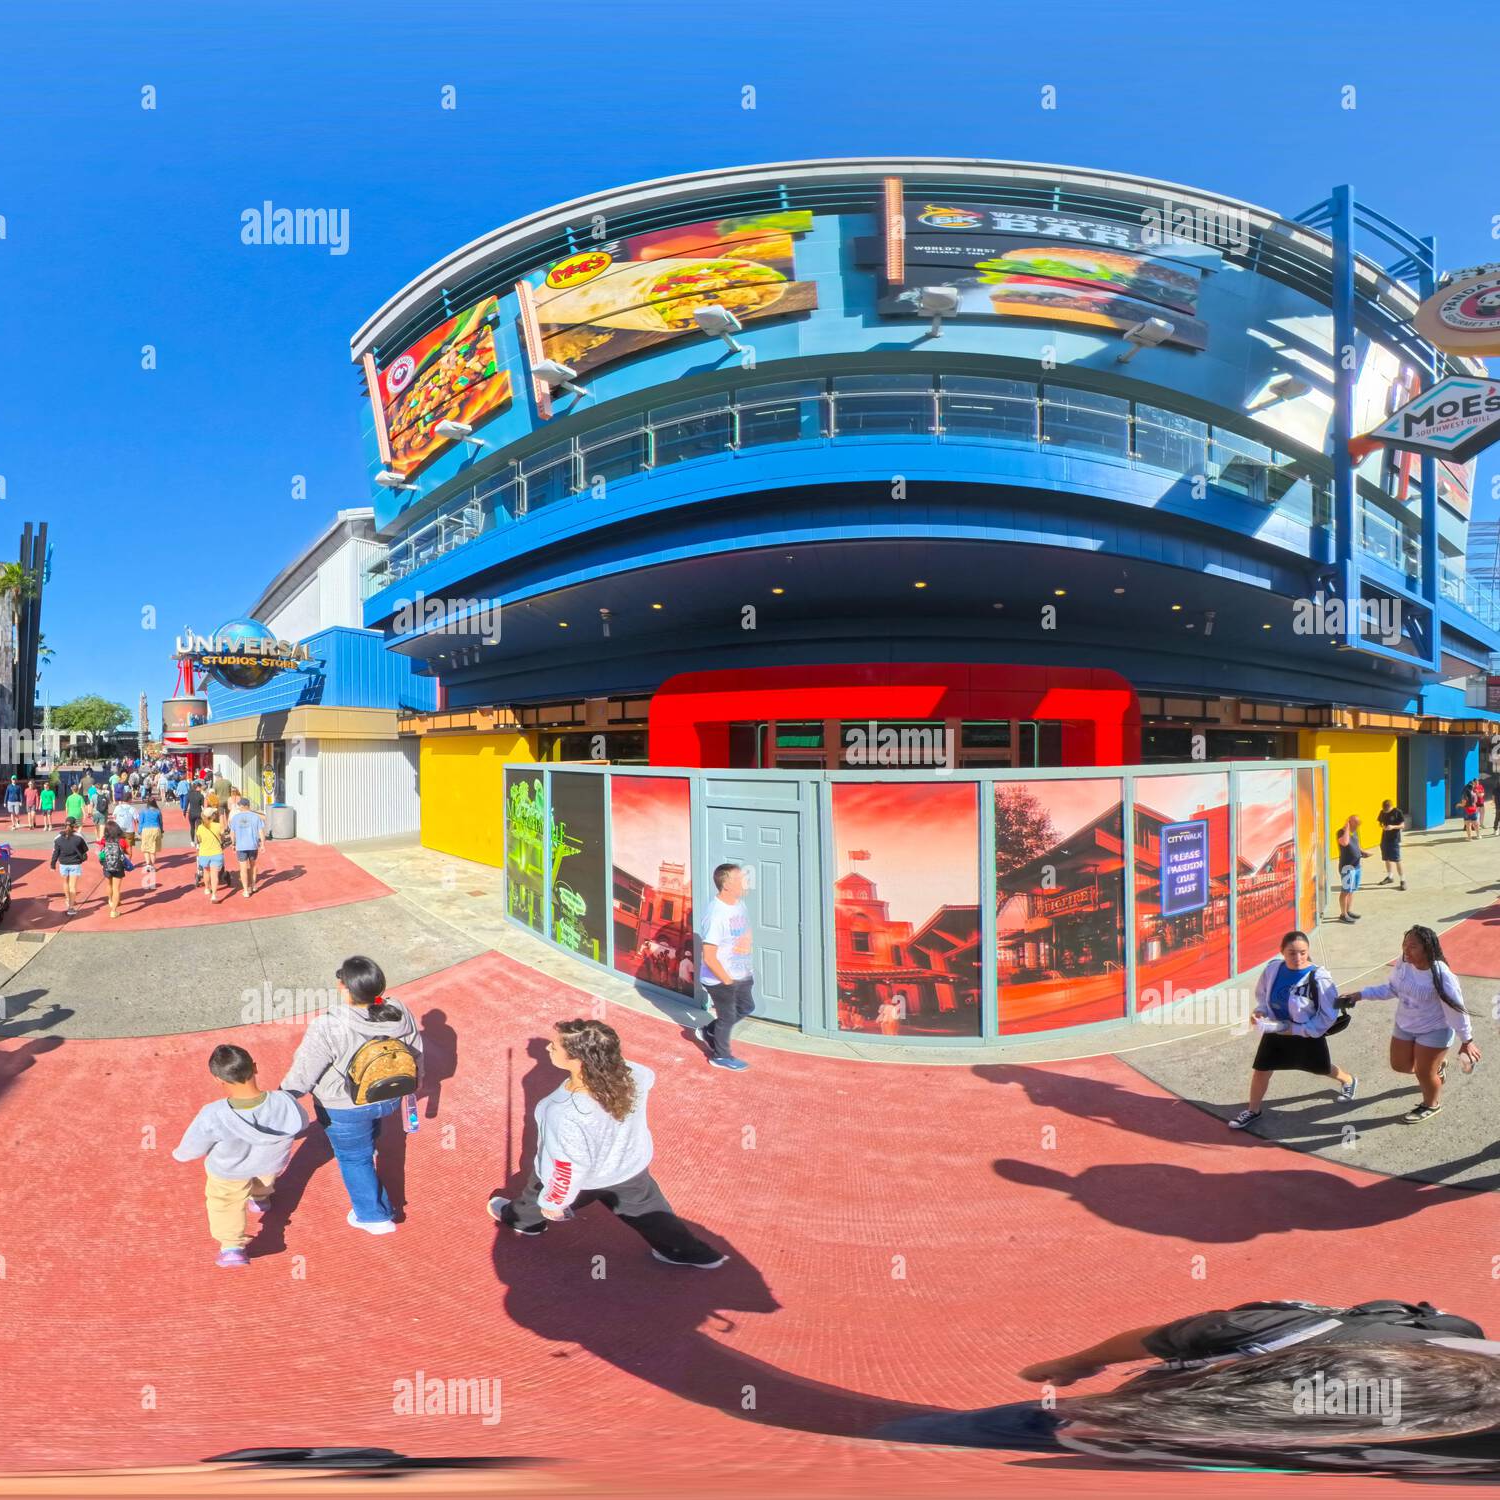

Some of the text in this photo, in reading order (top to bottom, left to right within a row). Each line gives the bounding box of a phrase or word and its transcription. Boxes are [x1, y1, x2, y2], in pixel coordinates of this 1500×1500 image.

[988, 211, 1130, 235] WHOPPER
[992, 217, 1130, 249] BAR
[1443, 283, 1490, 311] PANDA
[1445, 314, 1485, 327] GOURMET
[1416, 415, 1490, 437] SOUTHWEST GRILL
[176, 634, 311, 660] UNIVERSAL
[202, 656, 298, 669] STUDIOS STORE
[1167, 831, 1203, 844] CITYWALK
